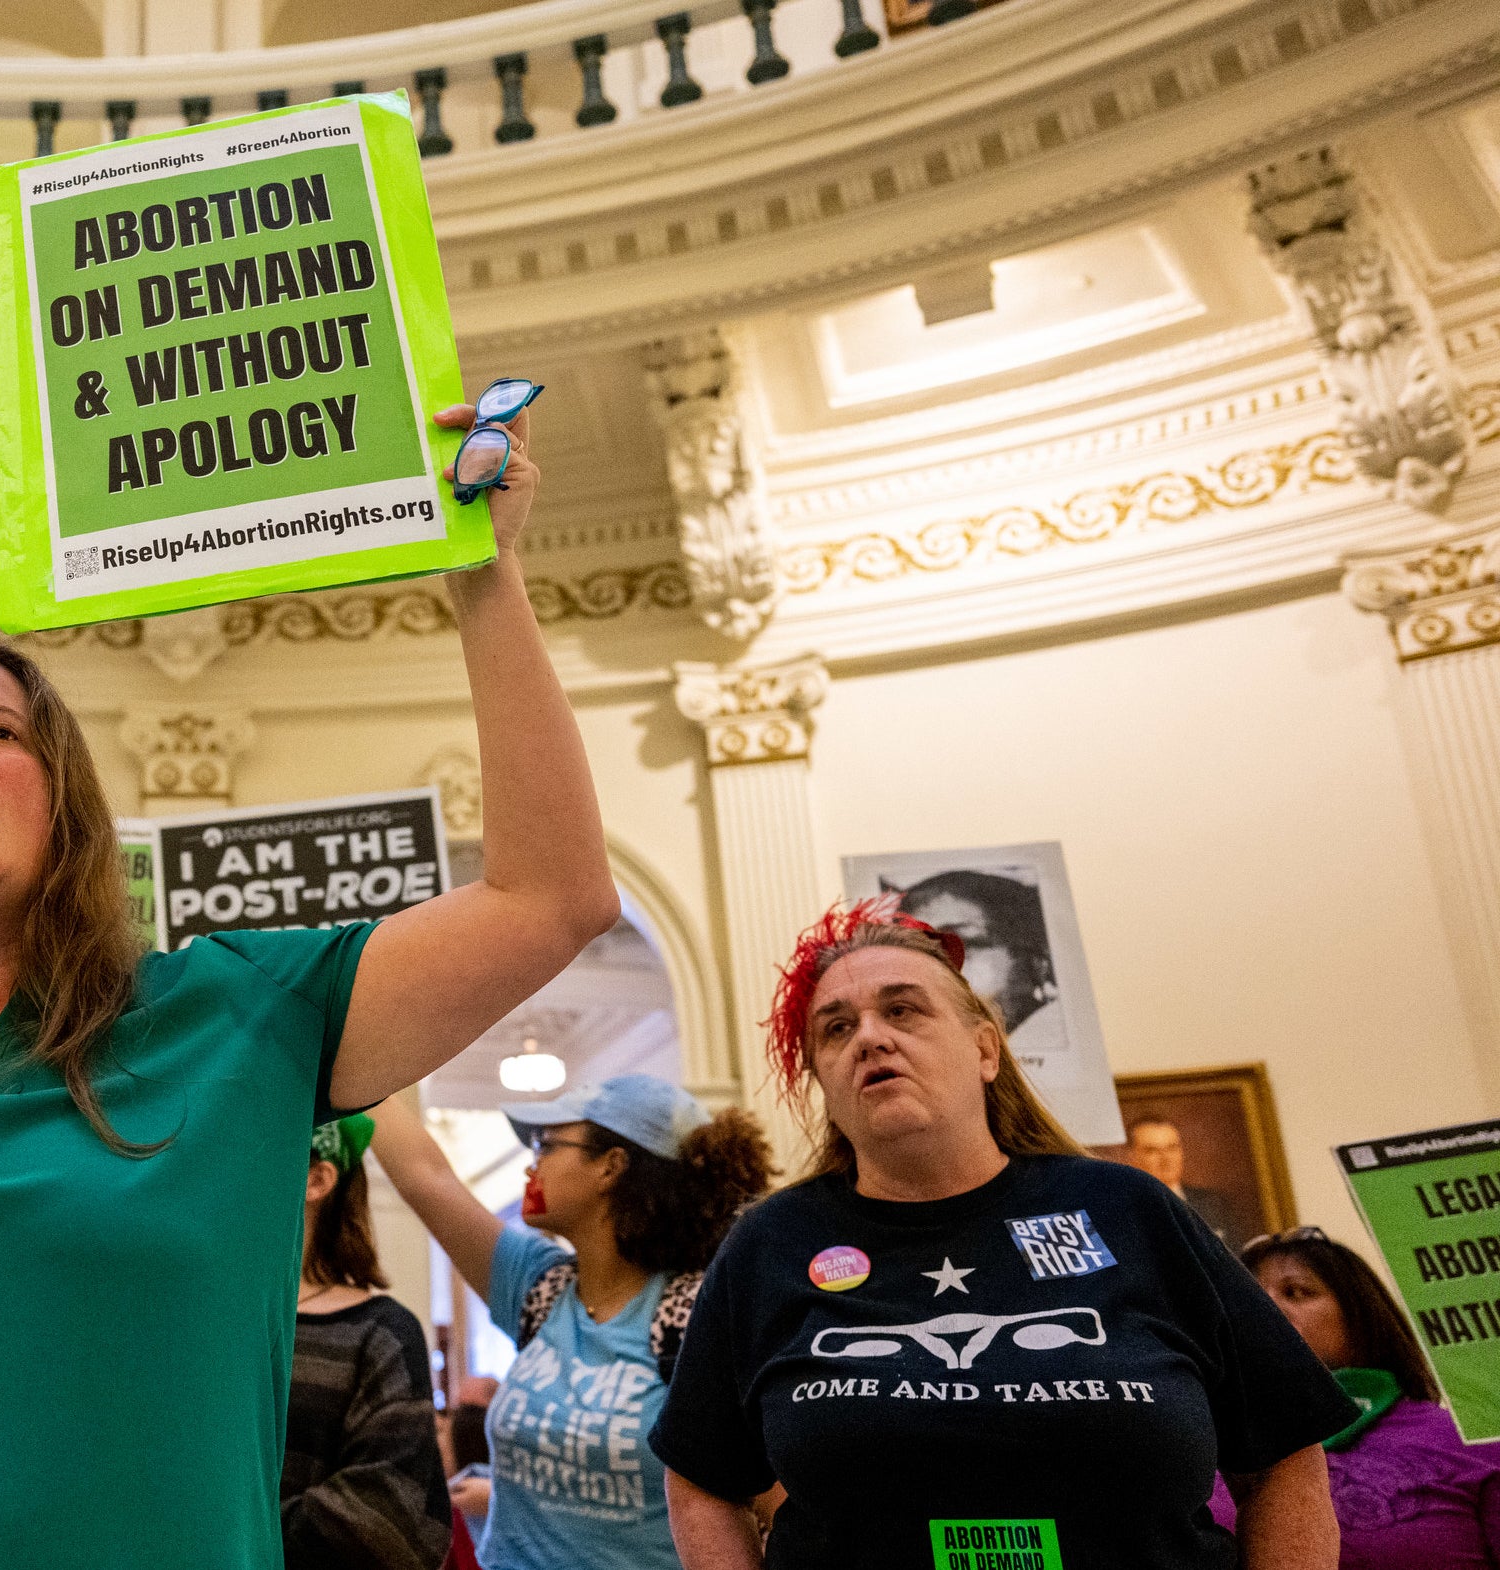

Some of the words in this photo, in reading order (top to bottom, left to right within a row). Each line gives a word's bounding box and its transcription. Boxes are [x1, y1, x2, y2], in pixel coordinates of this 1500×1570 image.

[32, 151, 204, 195] #RiseUp4AbortionRights
[226, 124, 351, 157] #Green4Abortion
[74, 173, 333, 270] ABORTION
[49, 286, 121, 349] ON
[137, 238, 377, 329] DEMAND
[73, 370, 111, 421] &
[125, 312, 372, 408] WITHOUT
[107, 393, 359, 495] APOLOGY
[102, 497, 435, 570] RiseUp4AbortionRights.org
[180, 851, 194, 882] I
[217, 841, 295, 878] AM
[316, 827, 416, 866] THE
[170, 862, 436, 927] POST-ROE
[1012, 1213, 1095, 1250] BETSY
[1021, 1238, 1104, 1278] RIOT
[814, 1254, 857, 1273] DISARM
[824, 1266, 853, 1282] HATE
[570, 1357, 656, 1413] THE
[792, 1379, 880, 1402] COME
[890, 1380, 980, 1401] AND
[995, 1379, 1106, 1402] TAKE
[1117, 1381, 1155, 1402] IT
[944, 1525, 1043, 1550] ABORTION
[948, 1552, 971, 1570] ON
[975, 1552, 1045, 1570] DEMAND
